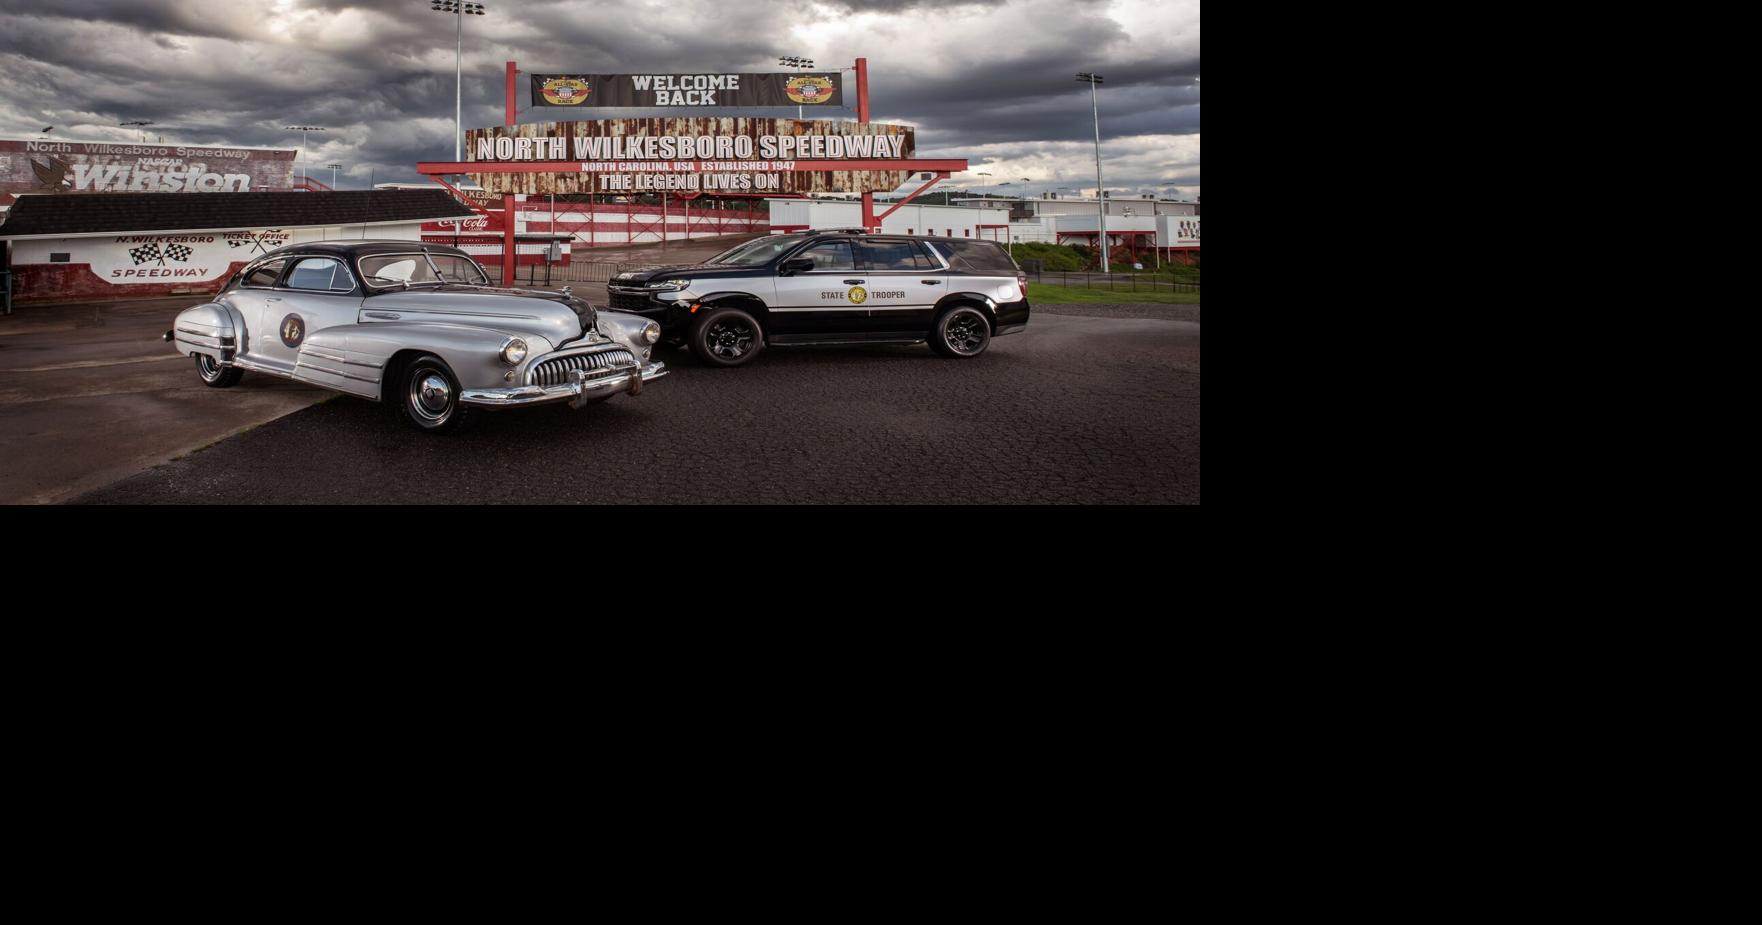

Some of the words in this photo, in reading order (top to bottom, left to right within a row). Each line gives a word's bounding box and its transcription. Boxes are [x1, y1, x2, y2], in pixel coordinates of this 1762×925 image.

[632, 75, 740, 91] WELCOME
[655, 90, 716, 106] BACK
[26, 141, 72, 153] North
[84, 143, 169, 156] Wilkesboro
[176, 147, 251, 160] Speedway
[477, 136, 567, 160] NORTH
[573, 135, 753, 160] WILKESBORO
[759, 134, 905, 159] SPEEDWAY
[581, 162, 617, 172] NORTH
[674, 162, 695, 171] USA
[701, 161, 769, 171] ESTABLISHED
[771, 161, 796, 171] 1947
[71, 163, 251, 193] Winston
[599, 174, 632, 190] THE
[635, 174, 700, 190] LEGEND
[703, 174, 751, 189] LIVES
[754, 173, 780, 189] ON
[111, 268, 209, 278] SPEEDWAY
[821, 291, 844, 299] STATE
[871, 291, 905, 299] TROOPER
